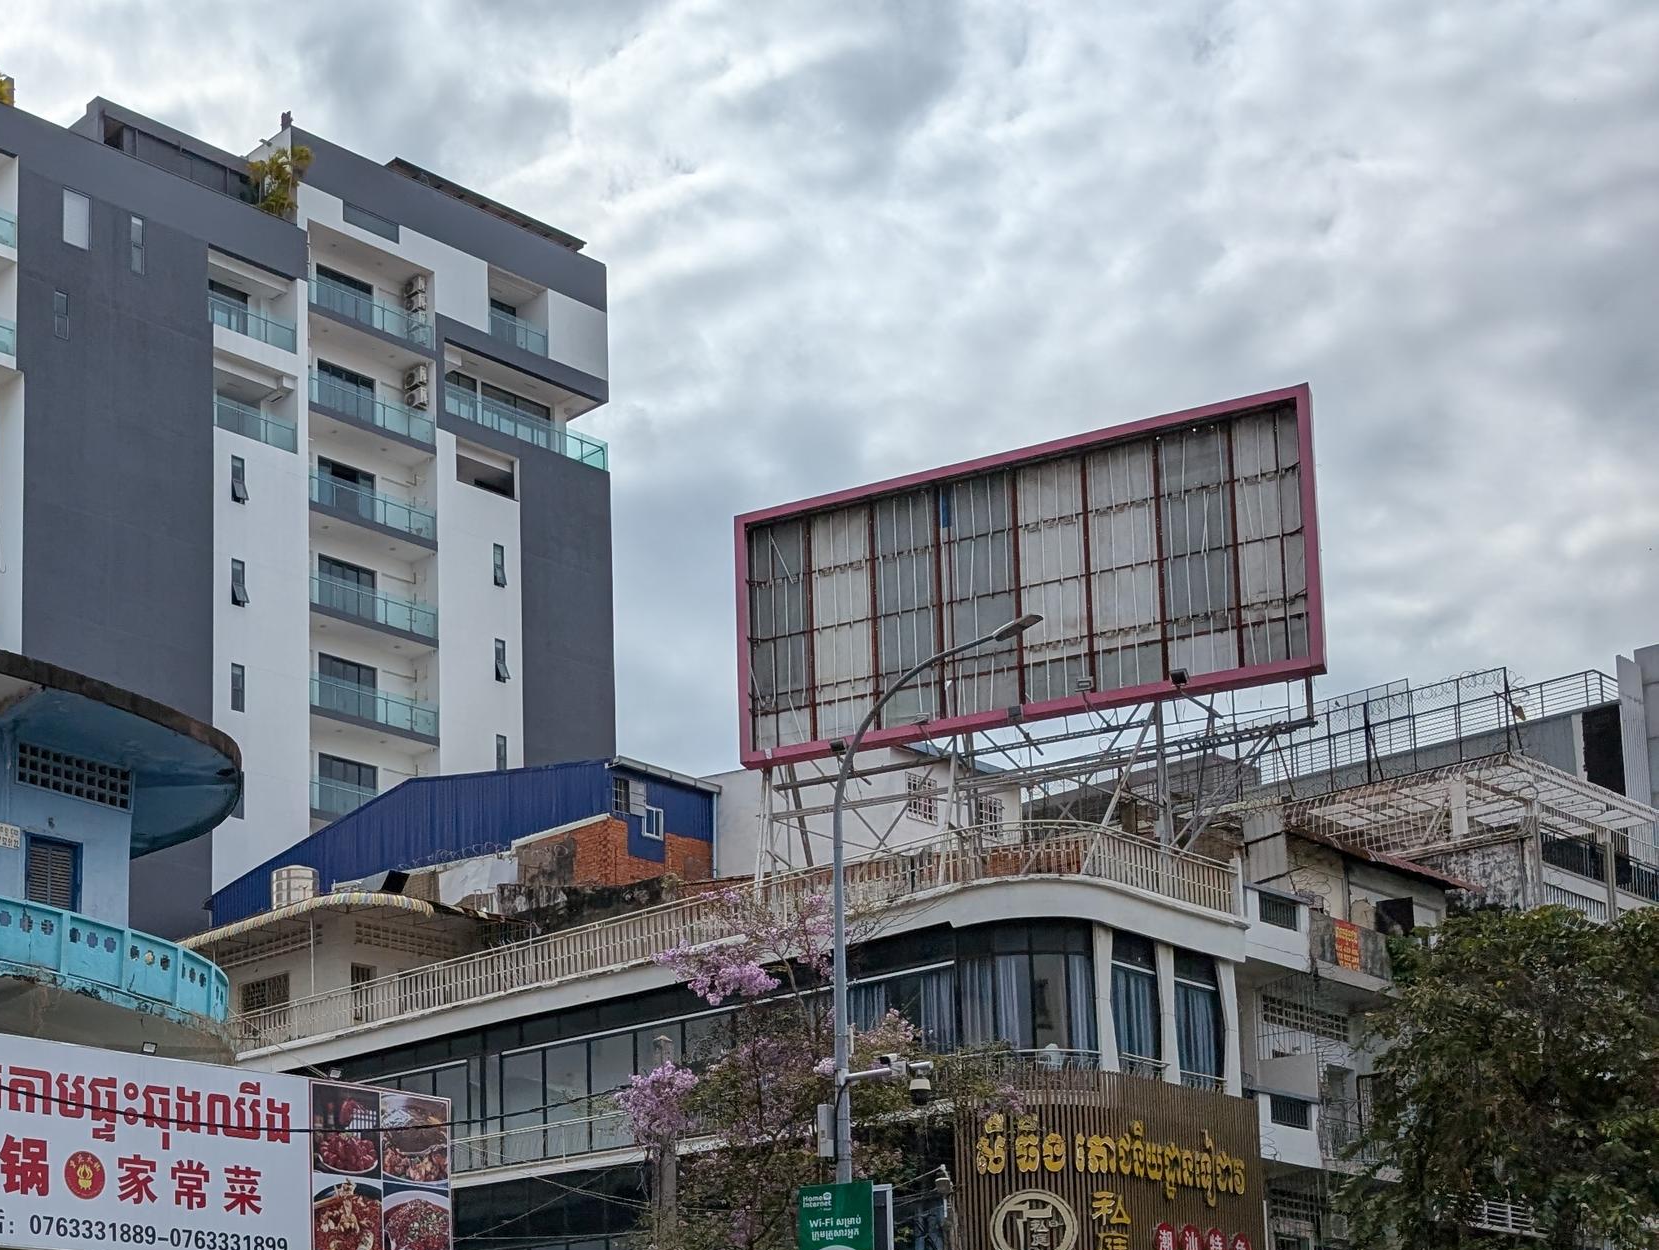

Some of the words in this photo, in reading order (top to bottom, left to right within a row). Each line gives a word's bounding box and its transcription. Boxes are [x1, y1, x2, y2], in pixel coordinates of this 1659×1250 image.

[116, 1153, 263, 1216] 家常菜
[803, 1195, 823, 1203] Home
[803, 1201, 833, 1209] Internet
[809, 1217, 834, 1228] Wi-Fi
